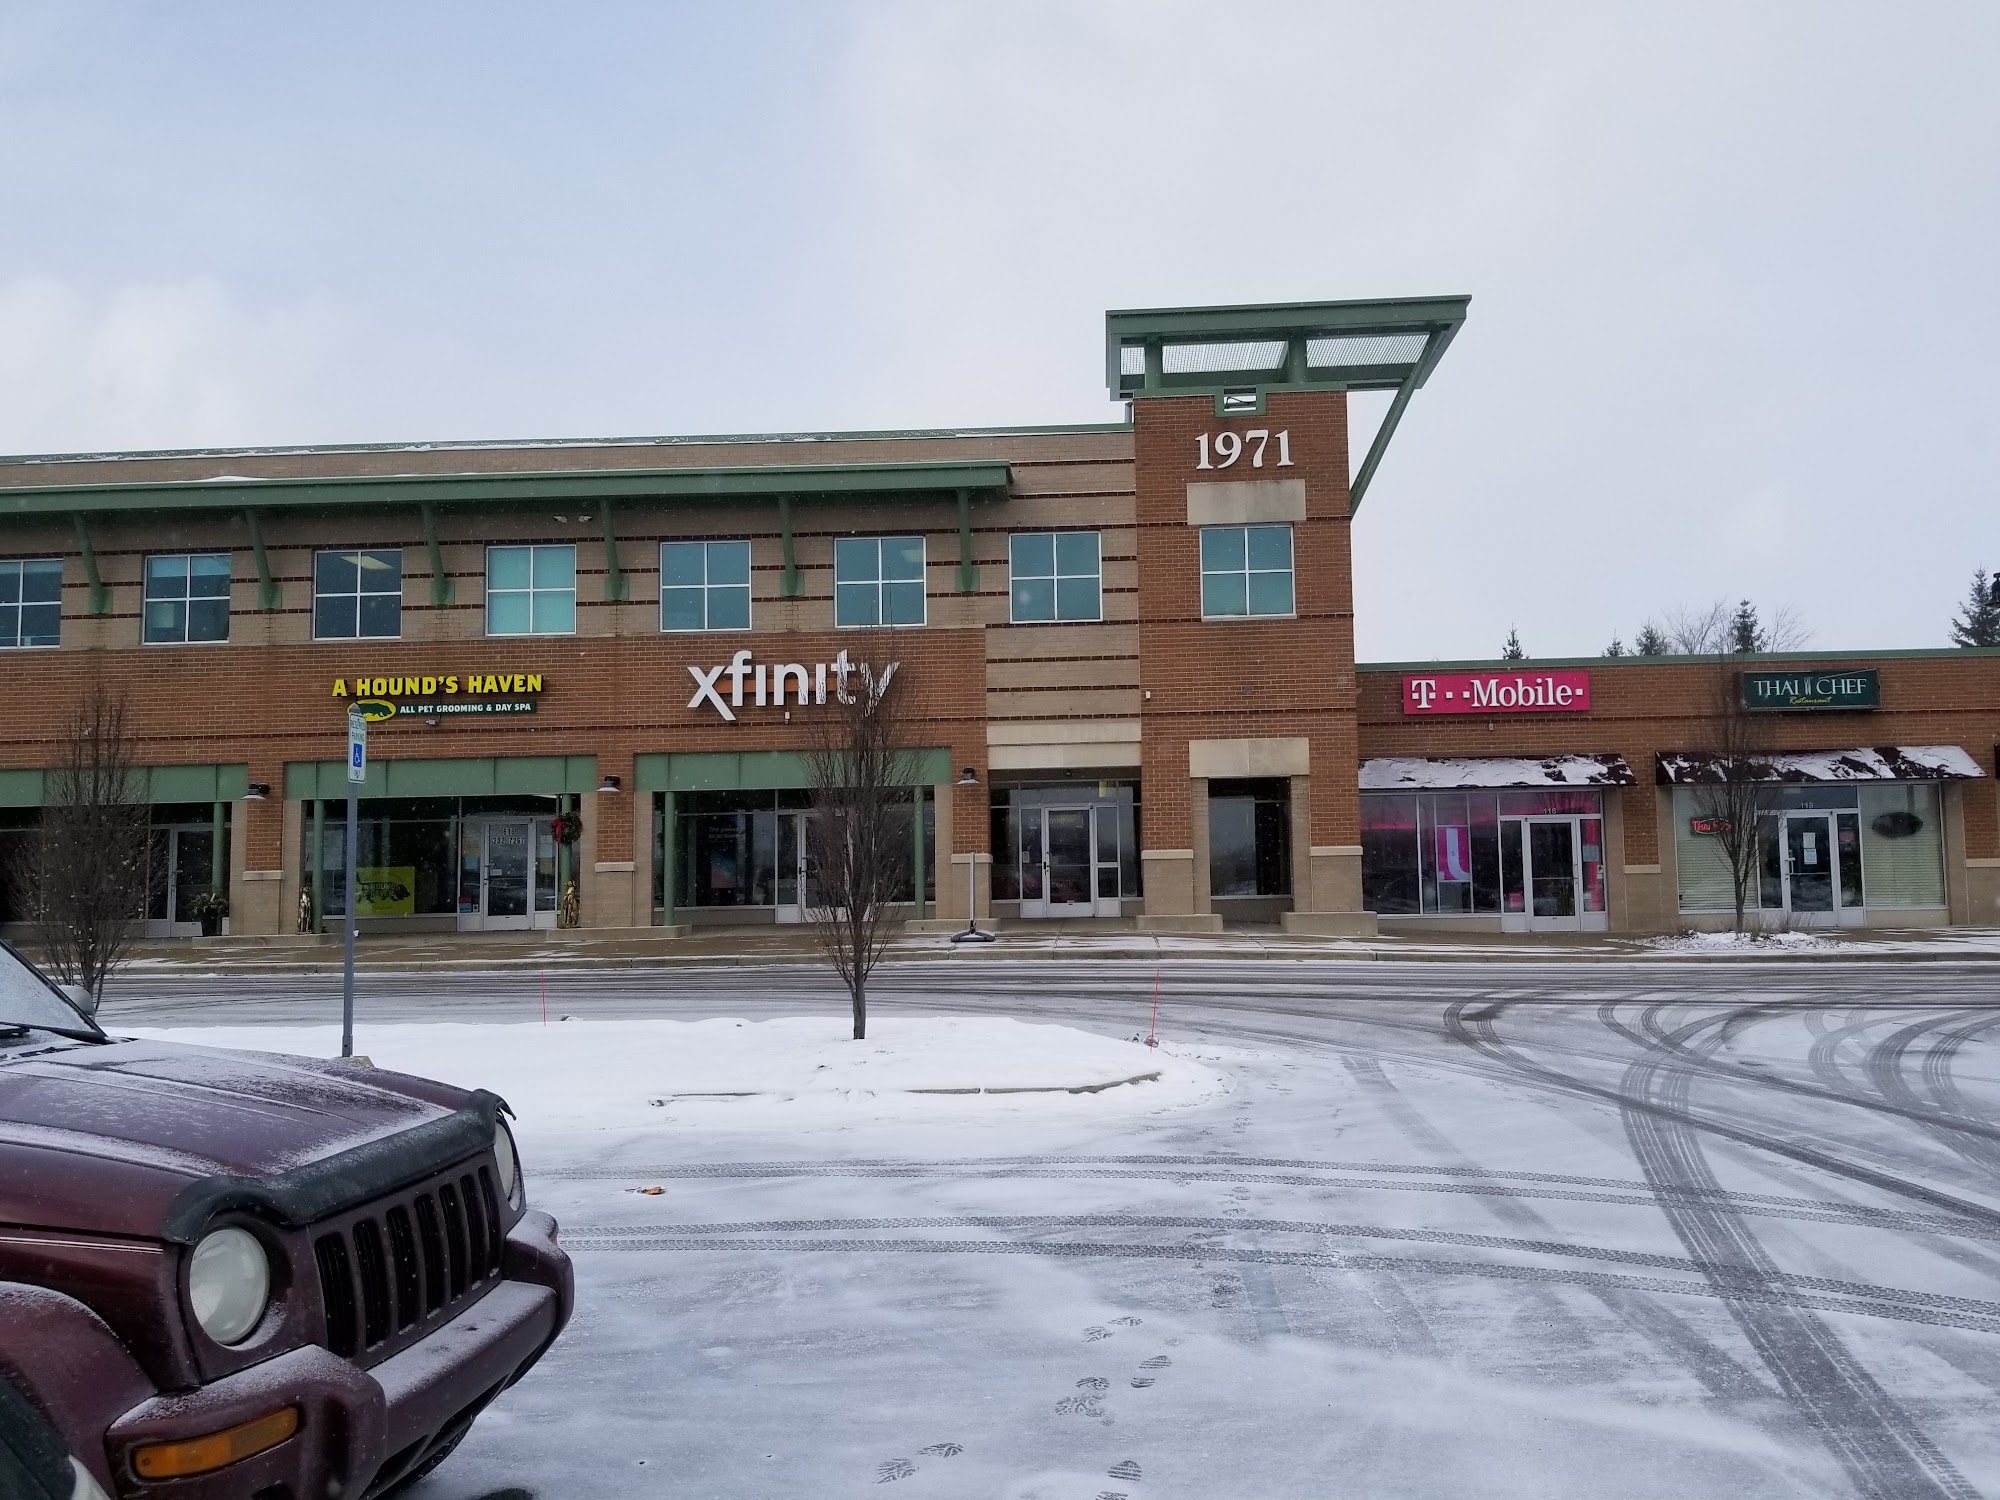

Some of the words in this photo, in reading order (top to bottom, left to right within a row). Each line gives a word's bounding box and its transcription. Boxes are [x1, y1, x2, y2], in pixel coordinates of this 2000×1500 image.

[1195, 430, 1295, 469] 1971
[331, 678, 348, 697] A
[356, 676, 458, 696] HOUND'S
[467, 674, 543, 693] HAVEN
[687, 648, 900, 721] xfinity
[1753, 679, 1800, 696] THAI
[1816, 678, 1867, 695] CHEF
[399, 705, 415, 714] ALL
[418, 705, 434, 713] PET
[436, 704, 484, 713] GROOMING
[486, 704, 493, 712] &
[495, 703, 513, 711] DAY
[514, 703, 531, 711] SPA
[1788, 696, 1833, 705] Restaurant
